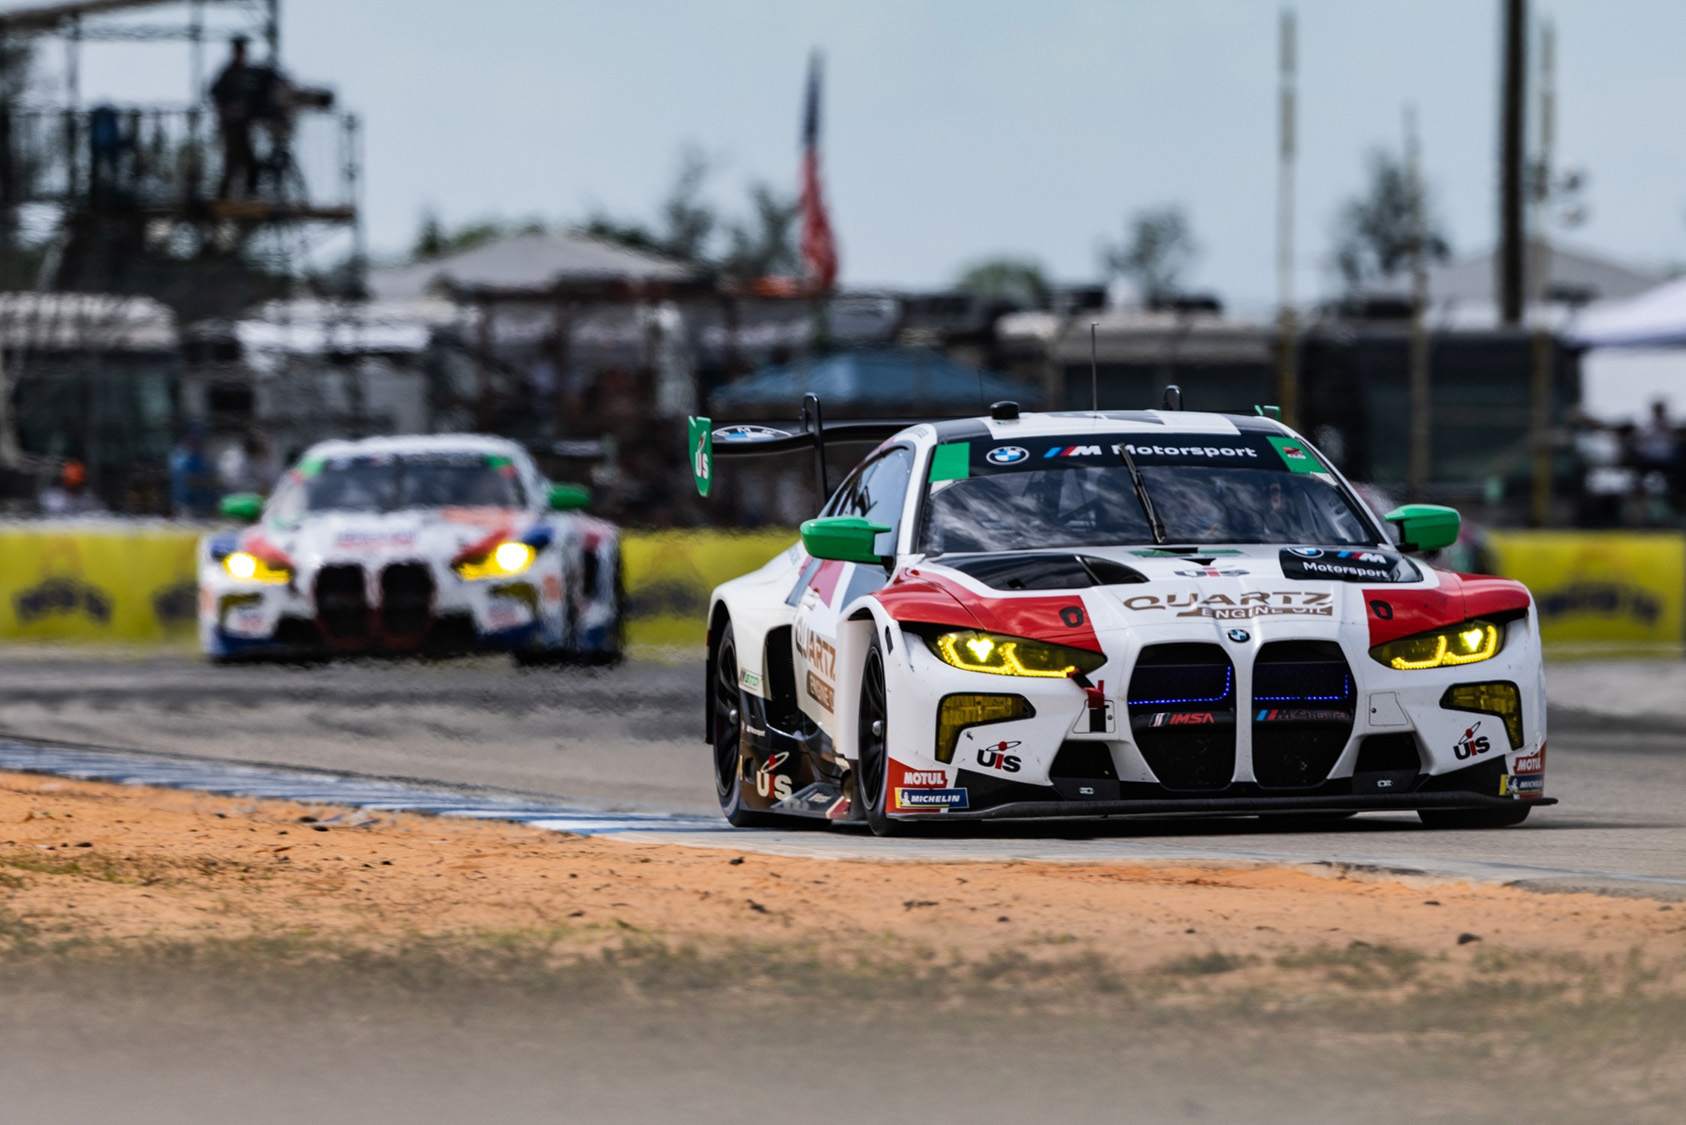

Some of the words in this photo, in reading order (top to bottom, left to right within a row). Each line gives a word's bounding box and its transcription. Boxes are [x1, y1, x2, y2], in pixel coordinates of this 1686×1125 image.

[1111, 444, 1258, 458] Motorsport
[1302, 561, 1389, 578] Motorsport
[1123, 591, 1333, 611] QUARTZ
[1169, 712, 1215, 725] IMSA
[1517, 757, 1541, 771] MOTU
[903, 772, 944, 785] MOTUL
[911, 794, 960, 803] MICHELIN
